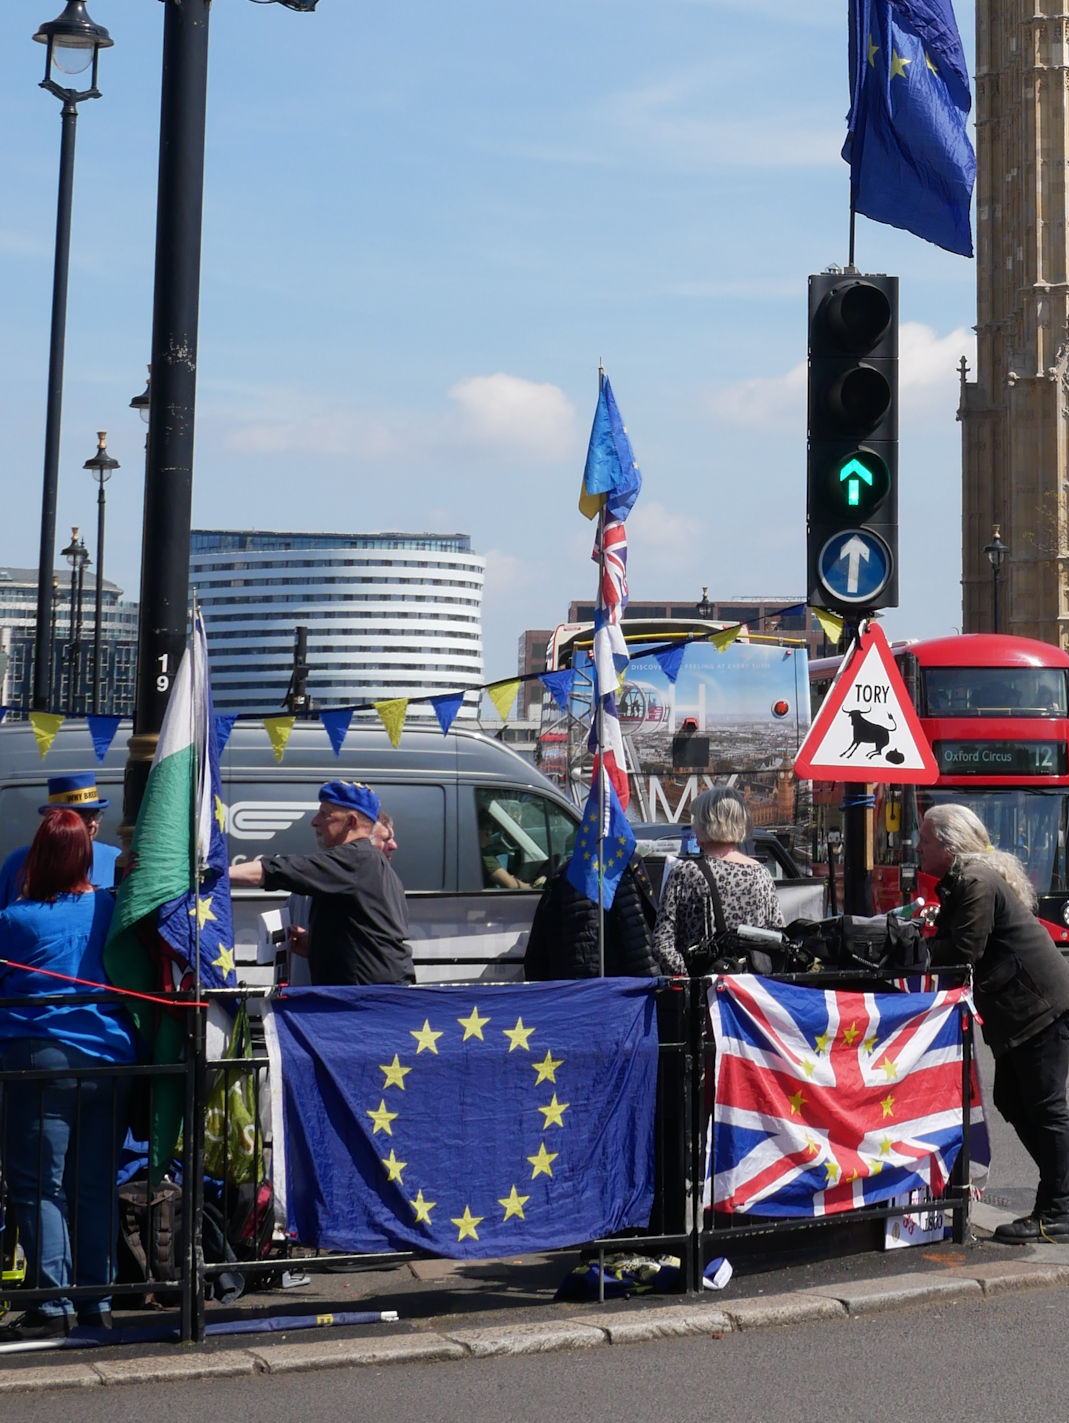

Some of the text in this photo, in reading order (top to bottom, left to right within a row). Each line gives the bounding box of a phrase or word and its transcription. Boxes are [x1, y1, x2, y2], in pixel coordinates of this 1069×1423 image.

[855, 684, 890, 704] TORY
[944, 746, 1053, 766] Oxford Circus 12
